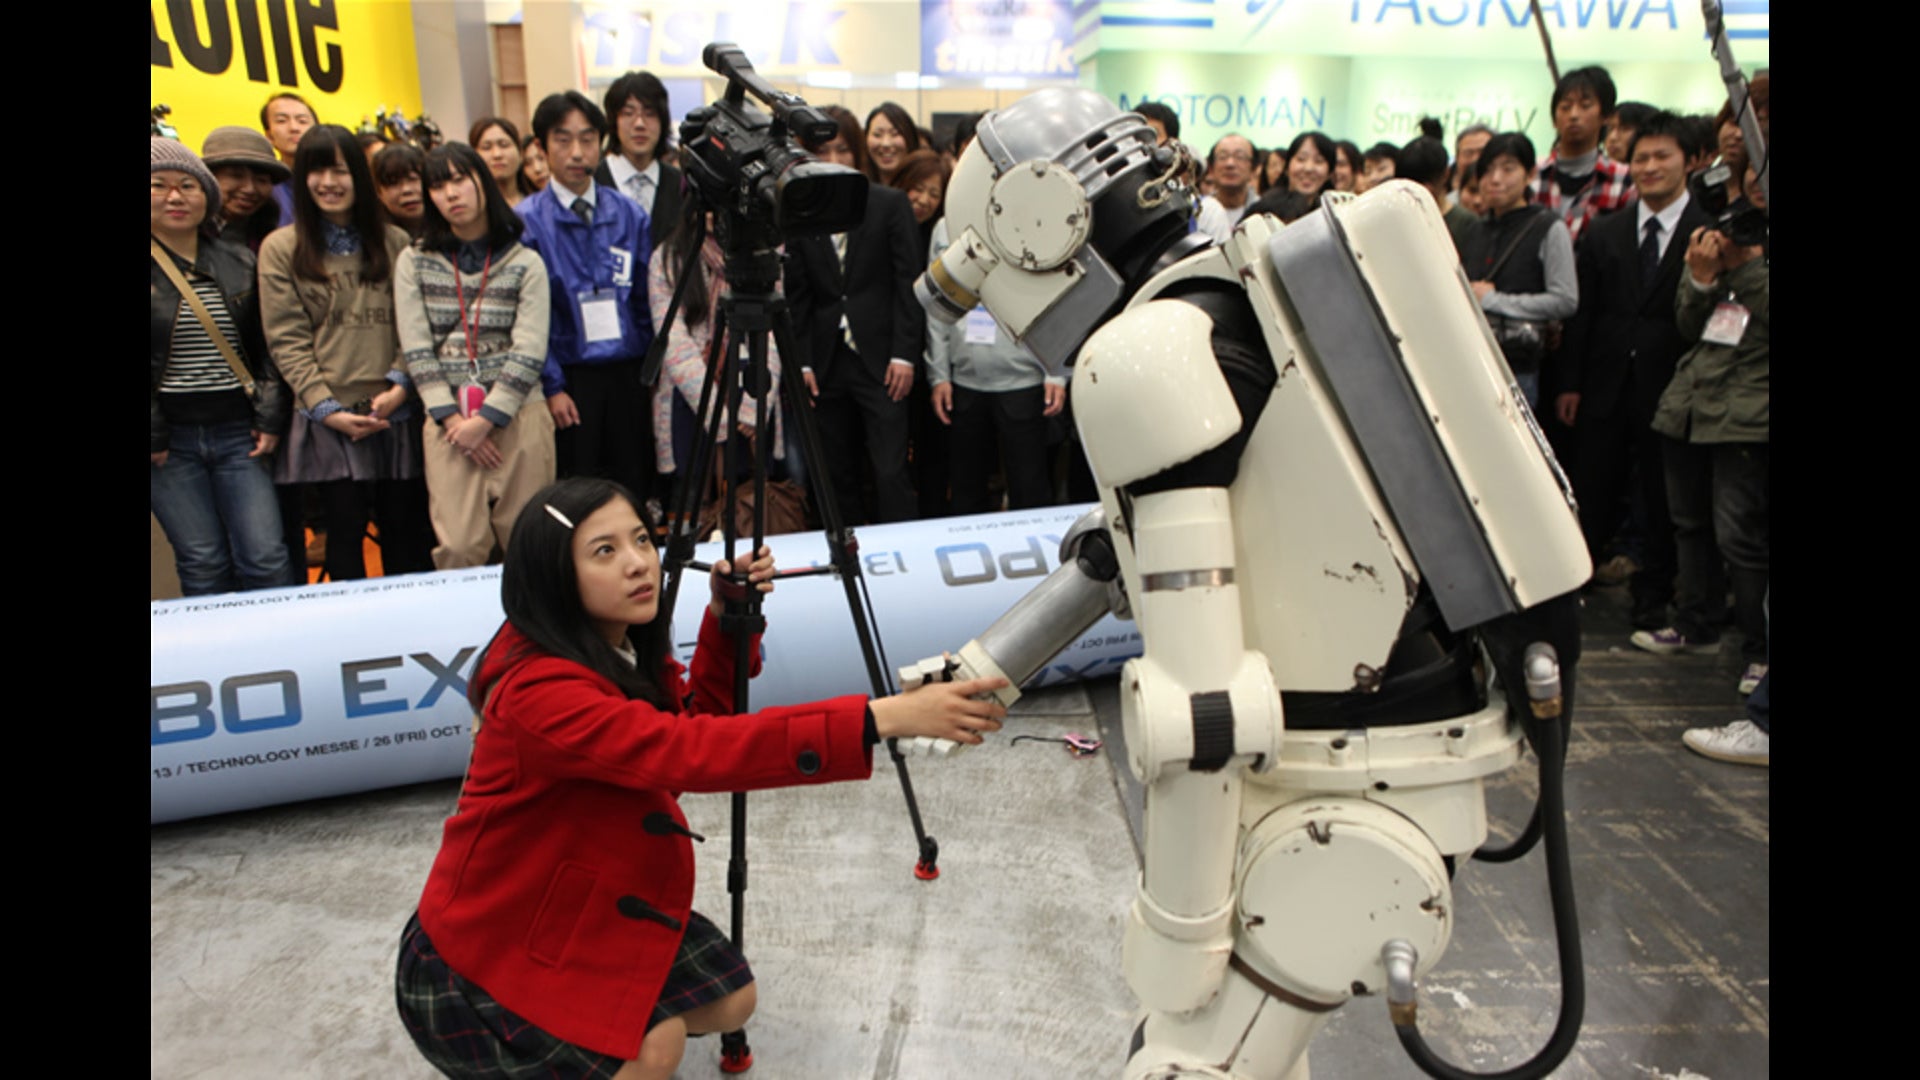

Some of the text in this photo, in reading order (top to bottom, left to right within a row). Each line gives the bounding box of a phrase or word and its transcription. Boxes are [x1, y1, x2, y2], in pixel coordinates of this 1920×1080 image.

[935, 534, 1062, 587] PO
[185, 595, 293, 612] TECHNOLOGY
[151, 669, 303, 746] BO
[186, 747, 301, 774] TECHNOLOGY
[305, 739, 360, 757] MESSE
[373, 735, 392, 747] 26
[394, 729, 427, 745] (FRI)
[430, 724, 462, 739] OCT
